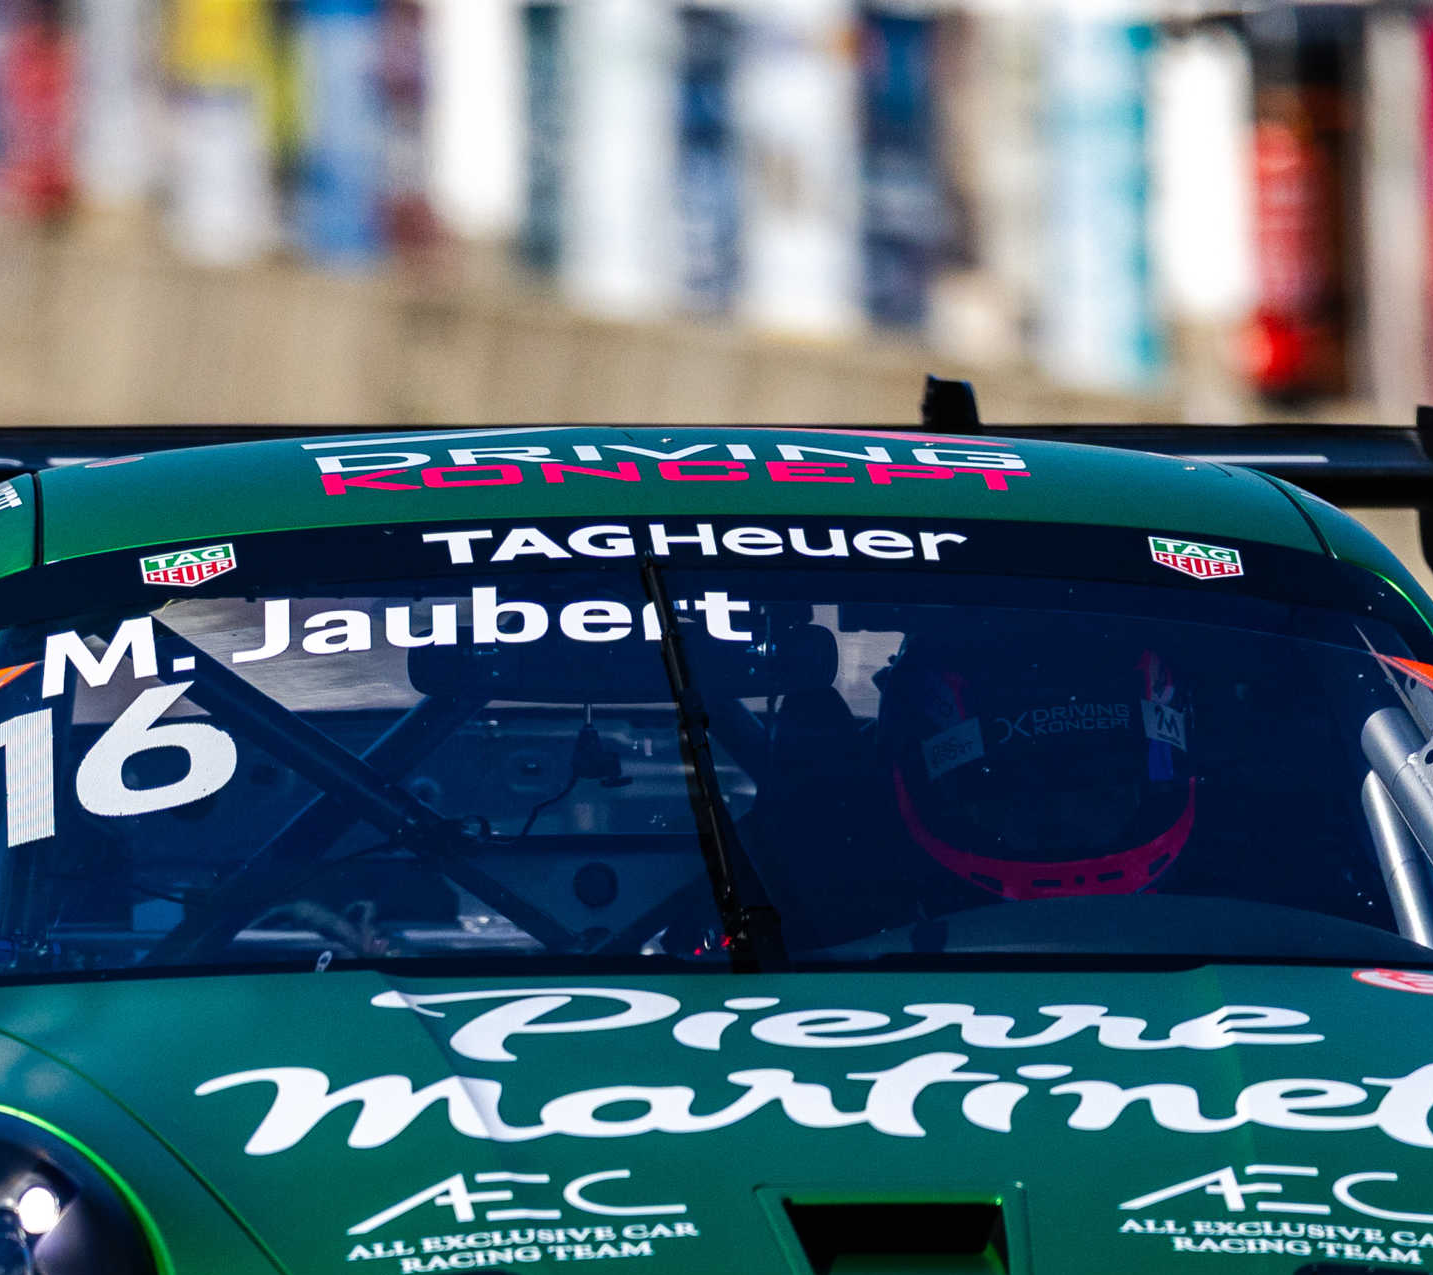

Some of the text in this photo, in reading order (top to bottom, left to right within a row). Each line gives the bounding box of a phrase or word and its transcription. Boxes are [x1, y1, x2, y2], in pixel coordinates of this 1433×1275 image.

[315, 444, 1026, 474] DRIVING
[320, 461, 1031, 496] KONCEPT
[148, 547, 225, 569] TAG
[1156, 541, 1232, 562] TAG
[1157, 554, 1236, 577] HEUER
[148, 560, 231, 584] HEUER
[41, 586, 753, 698] M. Jaubert
[371, 988, 1324, 1061] Pierre
[347, 1222, 699, 1261] ALL EXCLUSIVE CAR
[1119, 1219, 1186, 1235] ALL
[1192, 1221, 1385, 1244] EXCLUSIVE
[401, 1241, 653, 1274] RACING TEAM
[1173, 1236, 1423, 1265] RACING TEAM
